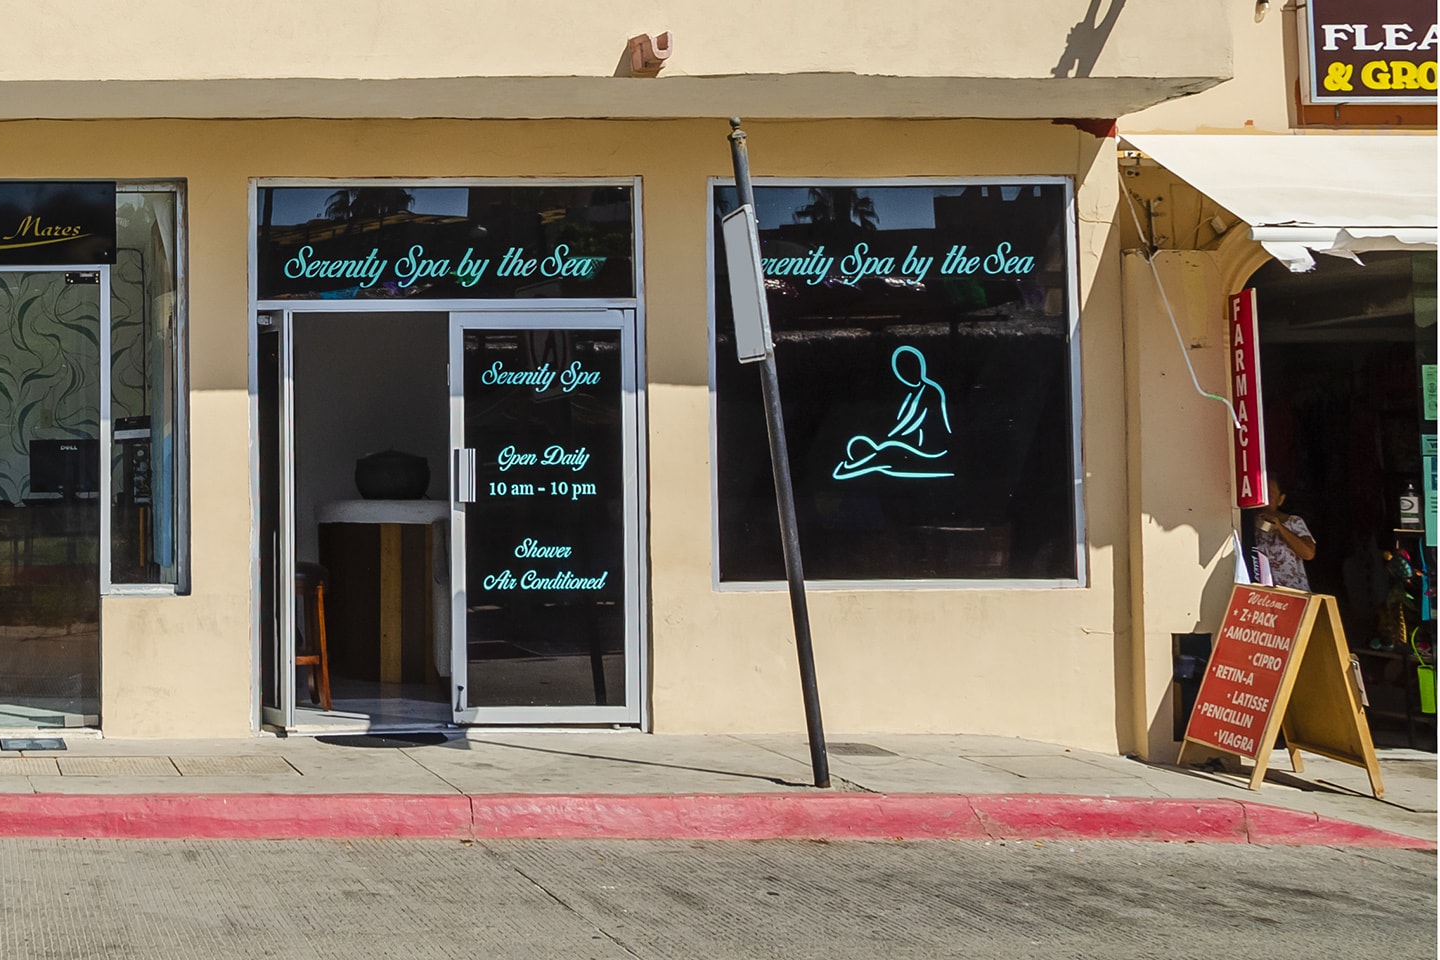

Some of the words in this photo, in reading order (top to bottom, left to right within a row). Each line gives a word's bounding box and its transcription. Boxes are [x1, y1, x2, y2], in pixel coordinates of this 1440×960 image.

[1323, 61, 1354, 92] &
[2, 214, 81, 240] Mares
[283, 244, 389, 289] Serenity
[393, 243, 451, 289] Spa
[456, 247, 491, 288] by
[496, 246, 538, 278] the
[539, 243, 593, 278] Sea
[760, 245, 835, 286] erenity
[839, 241, 897, 286] Spa
[900, 244, 935, 286] by
[939, 243, 981, 275] the
[982, 241, 1036, 275] Sea
[481, 360, 557, 393] Serenity
[560, 360, 601, 393] Spa
[1232, 296, 1253, 499] FARMACIA
[497, 445, 538, 472] Open
[540, 445, 591, 472] Daily
[489, 481, 507, 496] 10
[511, 483, 535, 496] am
[550, 481, 569, 496] 10
[571, 482, 597, 501] pm
[514, 537, 573, 559] Shower
[483, 569, 518, 591] Air
[519, 569, 609, 591] Conditioned
[1248, 591, 1289, 611] Welcome
[1225, 626, 1292, 651] AMOXICILINA
[1252, 652, 1283, 671] CIPRO
[1215, 664, 1255, 686] RETIN-A
[1231, 691, 1270, 713] LATISSE
[1200, 702, 1254, 729] PENICILLIN
[1217, 729, 1255, 753] VIAGRA
